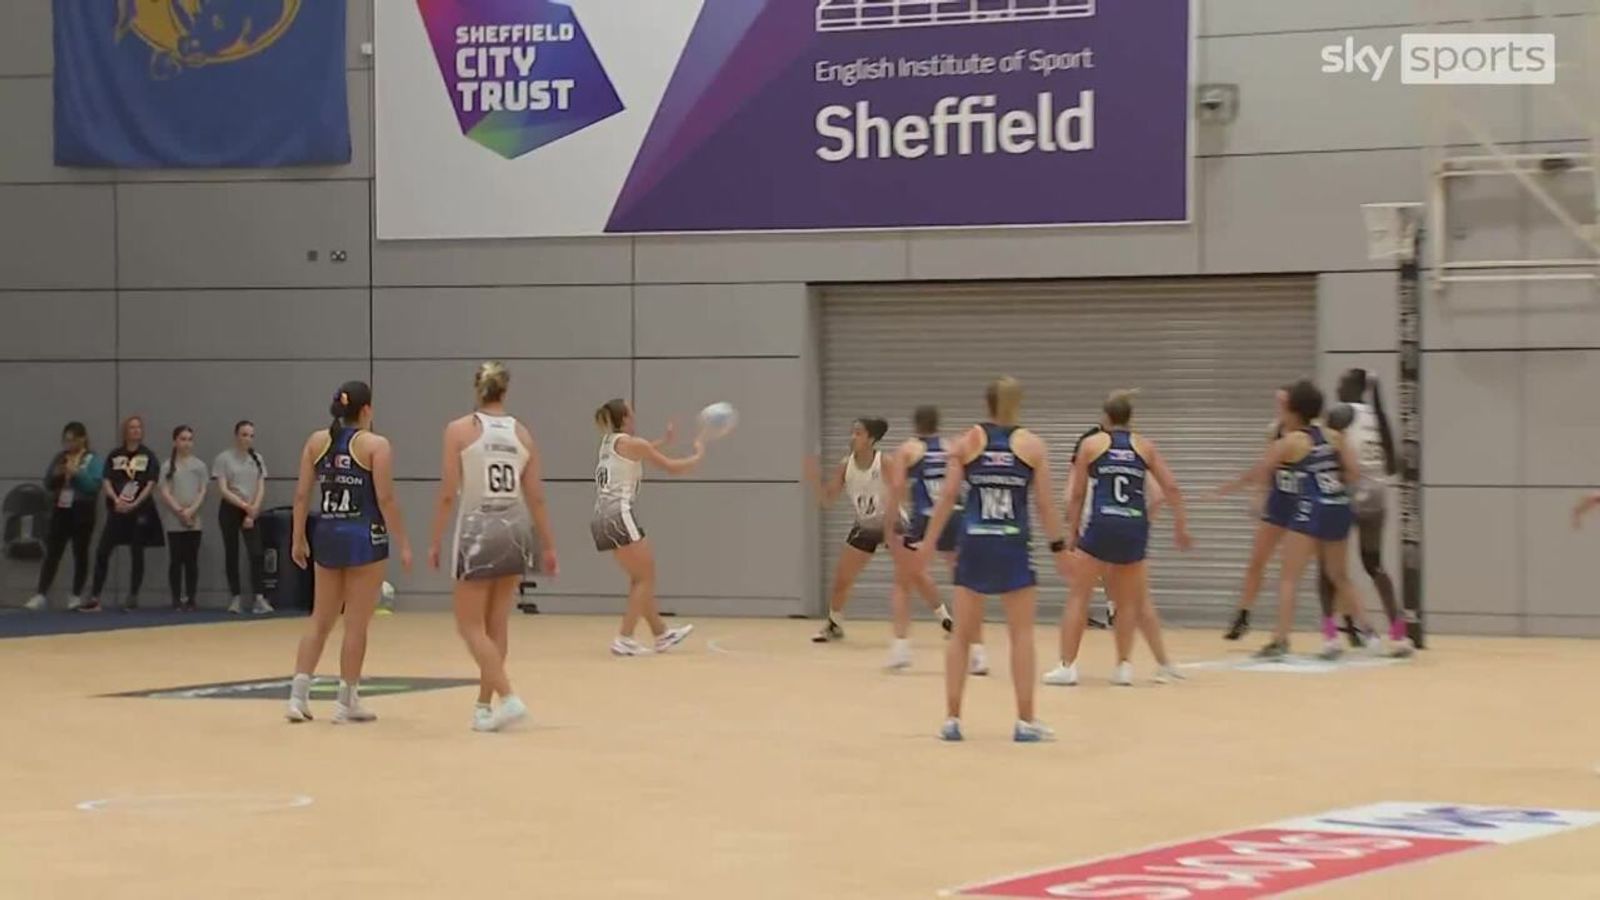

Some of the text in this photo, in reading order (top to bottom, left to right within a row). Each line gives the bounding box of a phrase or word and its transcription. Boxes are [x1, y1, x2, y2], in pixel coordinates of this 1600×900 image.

[456, 23, 574, 44] SHEFFIELD
[456, 46, 536, 78] CITY
[814, 47, 1095, 86] English Institute of Sport
[456, 79, 574, 112] TRUST
[815, 90, 1095, 162] Sheffield
[1114, 475, 1129, 503] C
